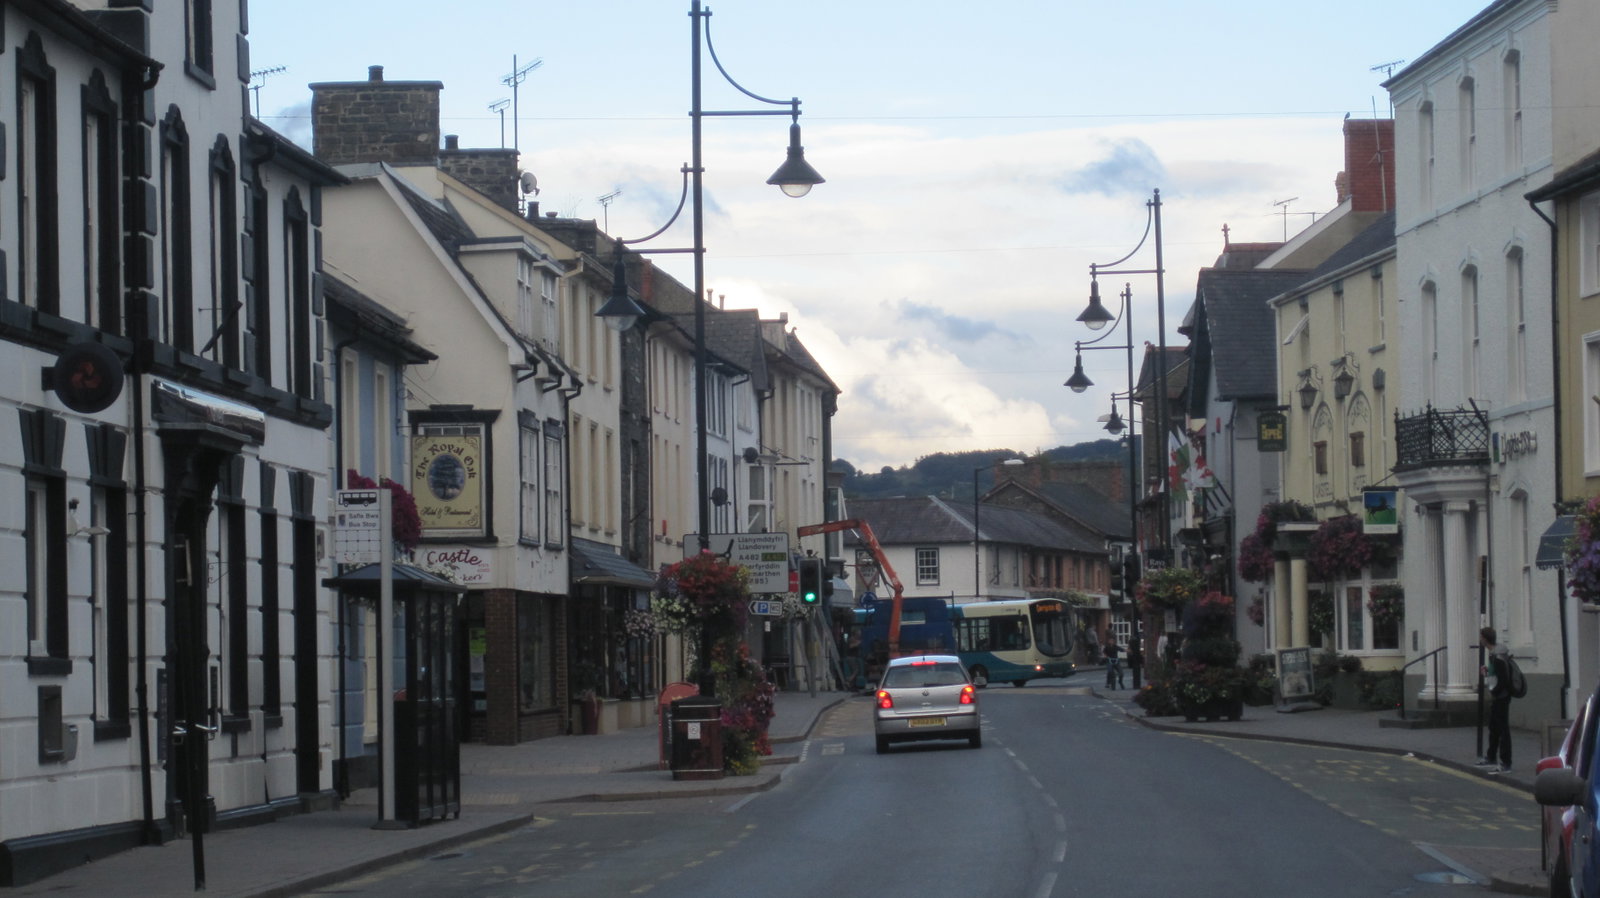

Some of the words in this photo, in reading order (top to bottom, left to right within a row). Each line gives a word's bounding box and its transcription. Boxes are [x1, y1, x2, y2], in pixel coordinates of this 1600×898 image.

[415, 456, 429, 480] The
[427, 443, 465, 456] Royal
[463, 455, 477, 480] Oak
[738, 543, 776, 551] Llandovery
